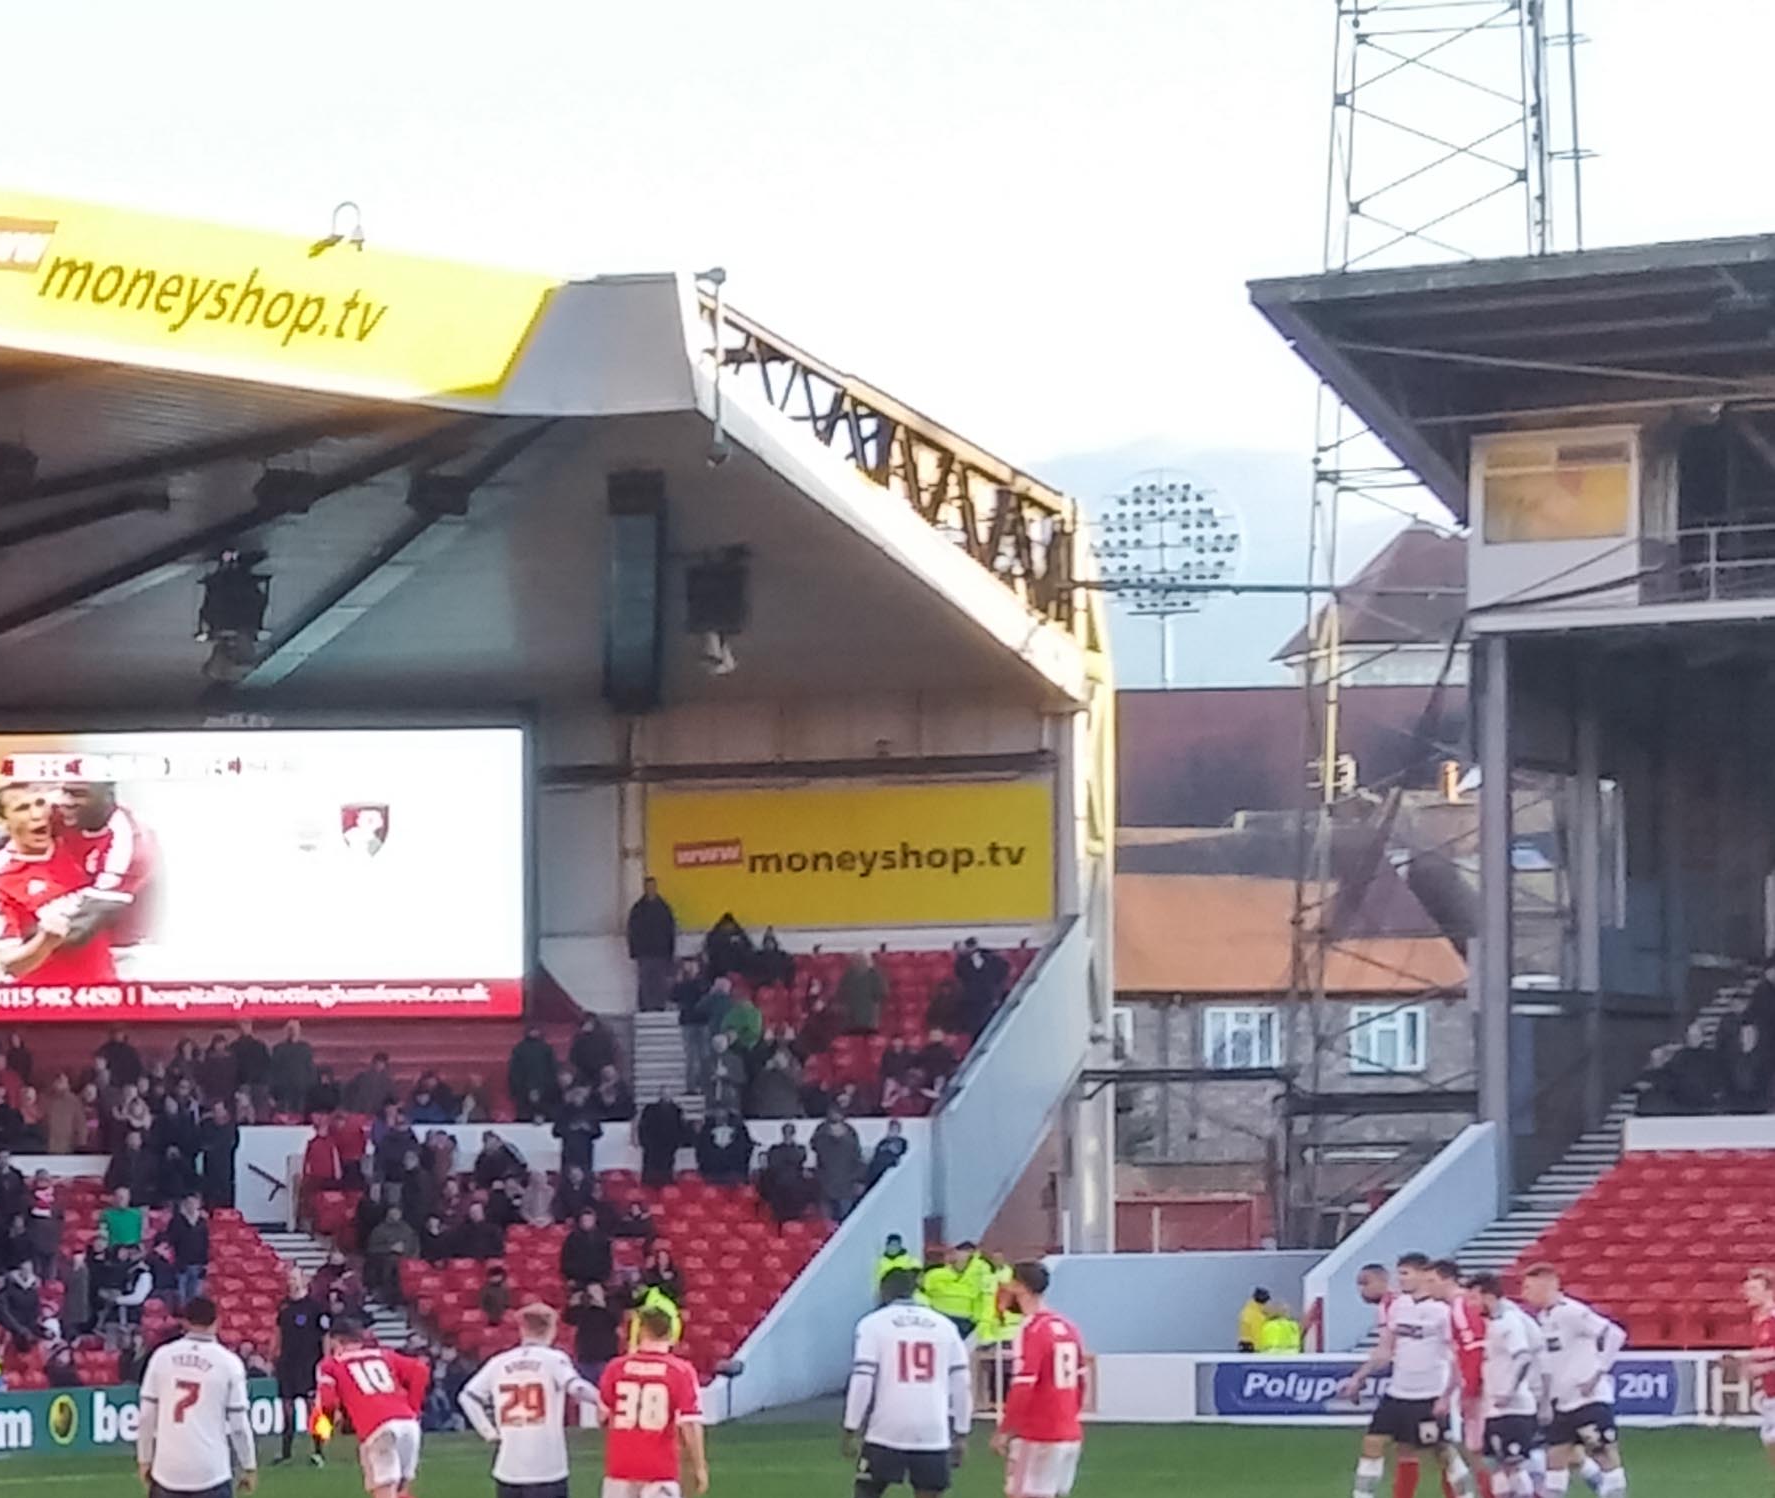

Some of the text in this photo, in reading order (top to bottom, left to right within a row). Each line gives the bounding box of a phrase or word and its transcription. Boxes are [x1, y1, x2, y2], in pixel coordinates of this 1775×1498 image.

[39, 255, 387, 345] moneyshop.tv
[675, 841, 1027, 877] www moneyshop.tv
[346, 1359, 395, 1395] 10
[898, 1341, 934, 1383] 19
[174, 1379, 201, 1423] 7
[499, 1384, 545, 1427] 29
[614, 1381, 669, 1431] 38
